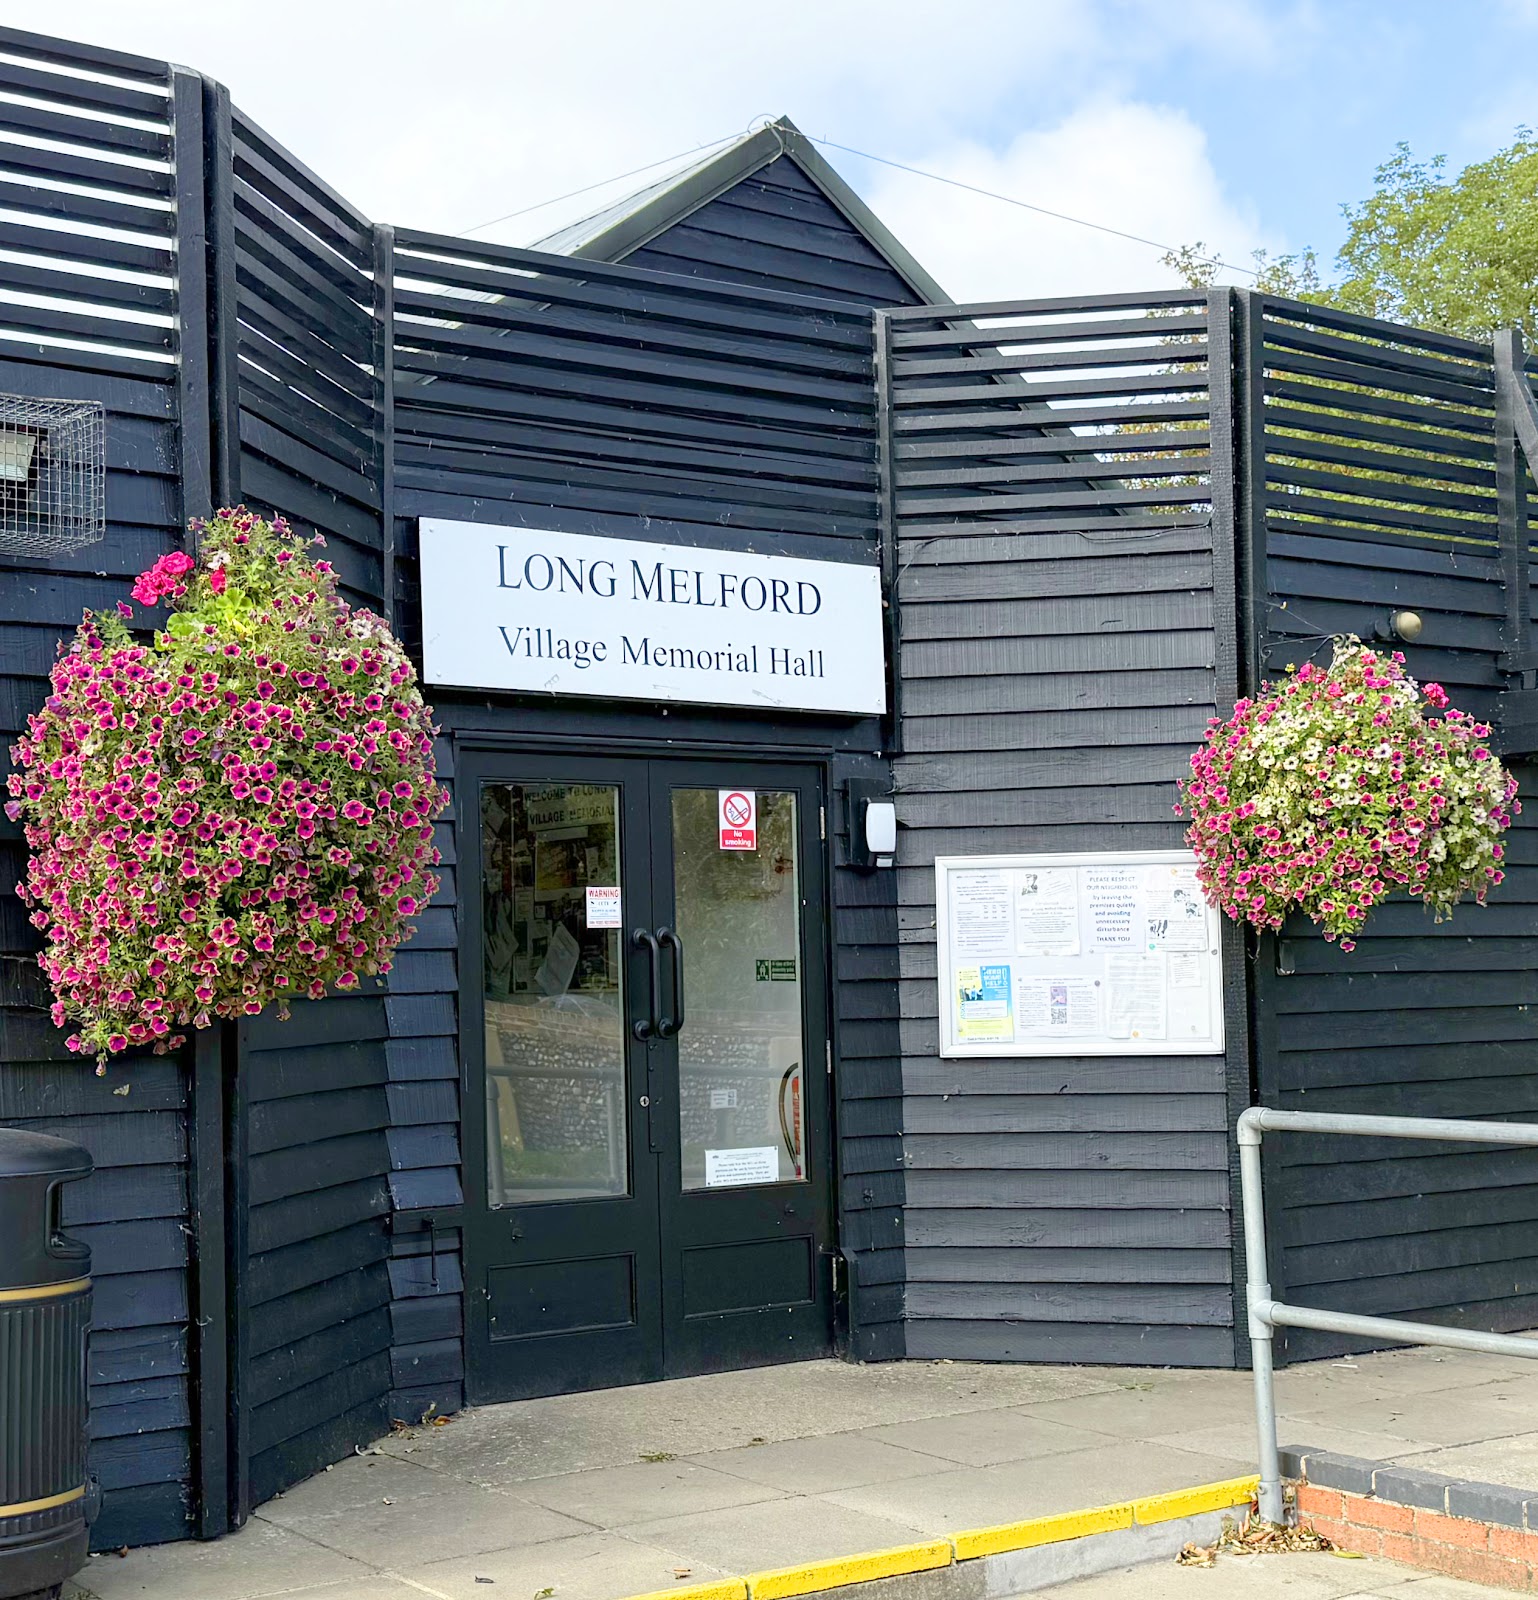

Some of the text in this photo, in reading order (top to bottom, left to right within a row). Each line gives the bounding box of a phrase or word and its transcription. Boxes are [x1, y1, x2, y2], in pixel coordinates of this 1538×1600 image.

[496, 545, 822, 615] LONG MELFORD
[497, 626, 824, 678] Village Memorial Hall
[524, 788, 566, 802] WELCOME
[529, 810, 565, 825] VILLAGE
[724, 838, 752, 848] smoking
[589, 889, 619, 897] WARNING
